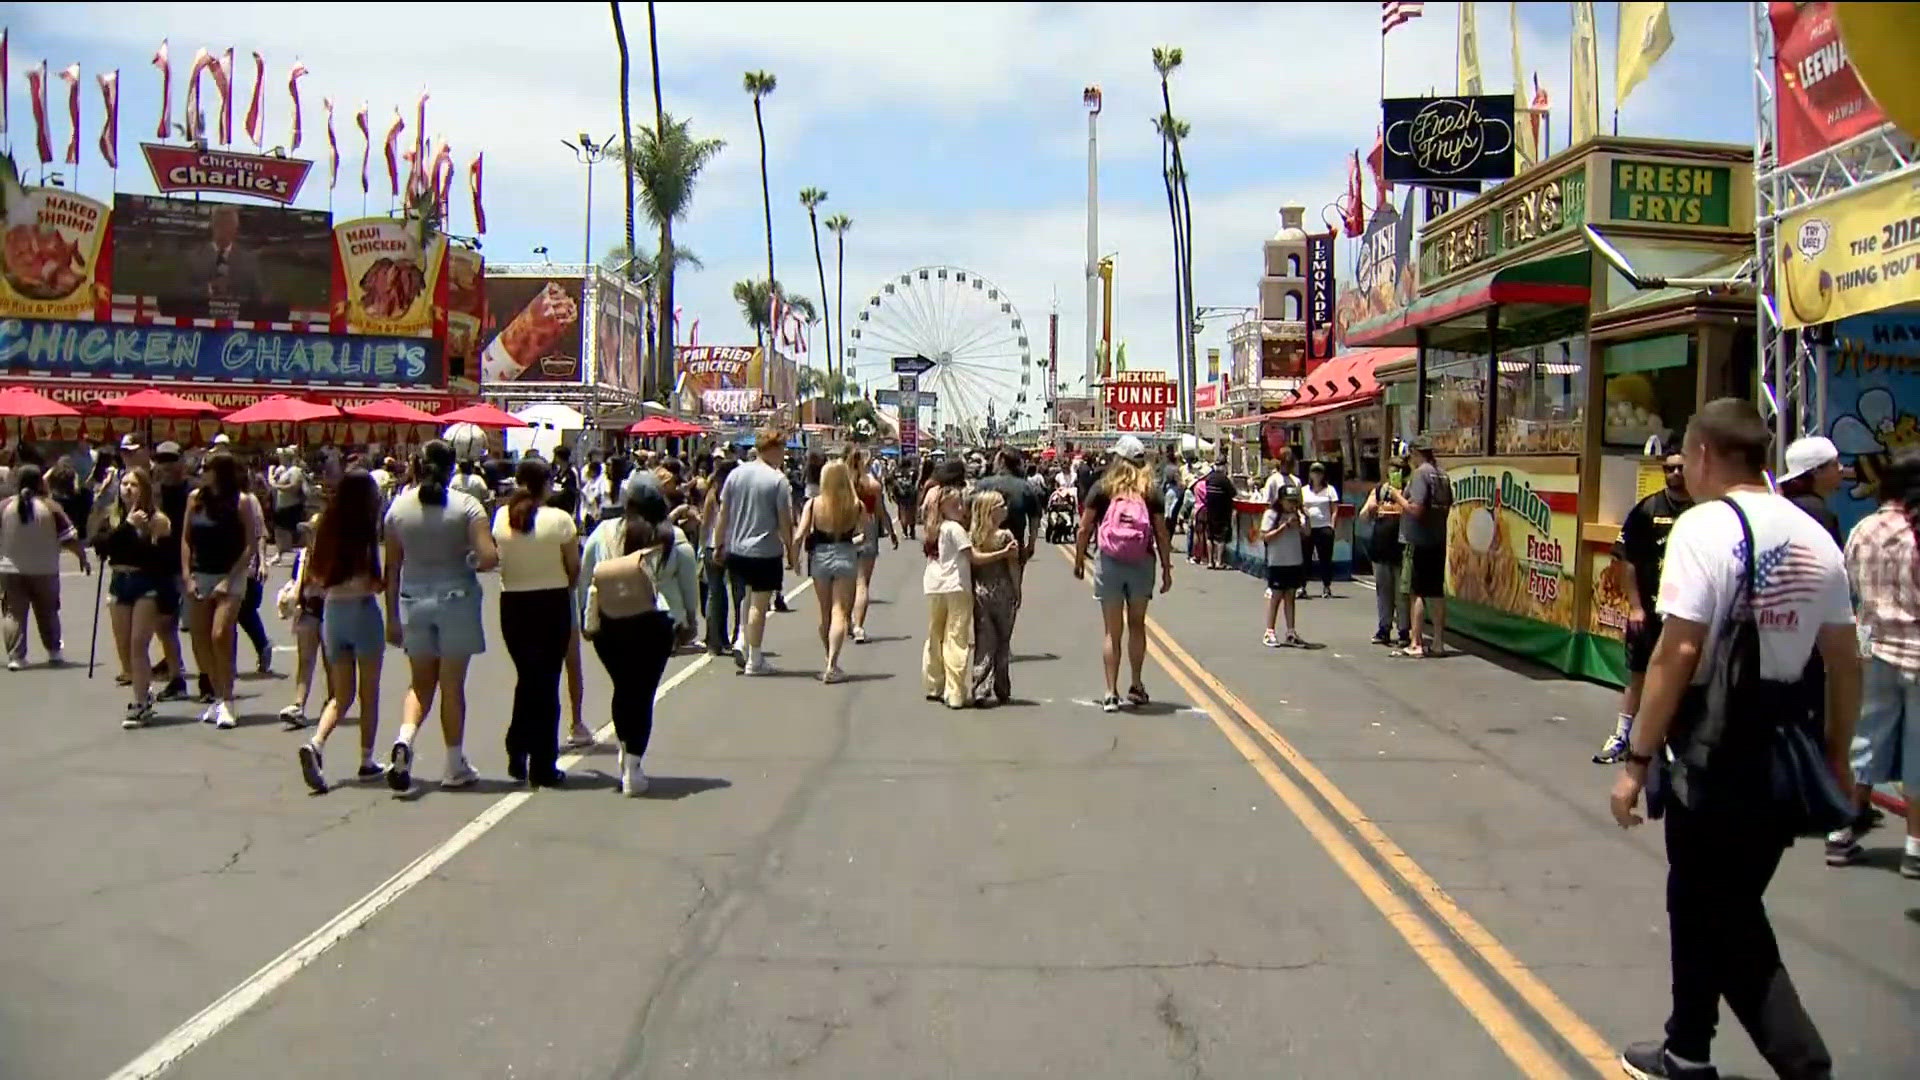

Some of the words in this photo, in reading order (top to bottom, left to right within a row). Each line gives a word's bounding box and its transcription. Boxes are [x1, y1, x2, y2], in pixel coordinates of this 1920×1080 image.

[1413, 98, 1482, 142] Fresh
[1418, 129, 1479, 168] Frys
[199, 155, 263, 172] Chicken
[169, 166, 288, 194] Charlie's
[1618, 164, 1713, 196] FRESH
[46, 196, 98, 221] NAKED
[1628, 193, 1702, 223] FRYS
[37, 210, 95, 234] SHRIMP
[346, 227, 380, 243] MAUI
[1805, 225, 1820, 236] TRY
[350, 240, 408, 257] CHICKEN
[1372, 221, 1397, 265] FISH
[1312, 240, 1328, 322] LEMONADE
[1836, 265, 1878, 293] THING
[0, 318, 202, 368] CHICKEN
[221, 331, 426, 377] CHARLIE'S
[683, 348, 709, 363] PAN
[713, 348, 752, 361] FRIED
[690, 361, 741, 374] CHICKEN
[1118, 372, 1165, 382] MEXICAN
[713, 401, 747, 413] CORN
[1106, 386, 1175, 404] FUNNEL
[1118, 411, 1164, 428] CAKE
[1500, 470, 1552, 537] Onion
[1526, 534, 1562, 565] Fresh
[1529, 567, 1560, 602] Frys
